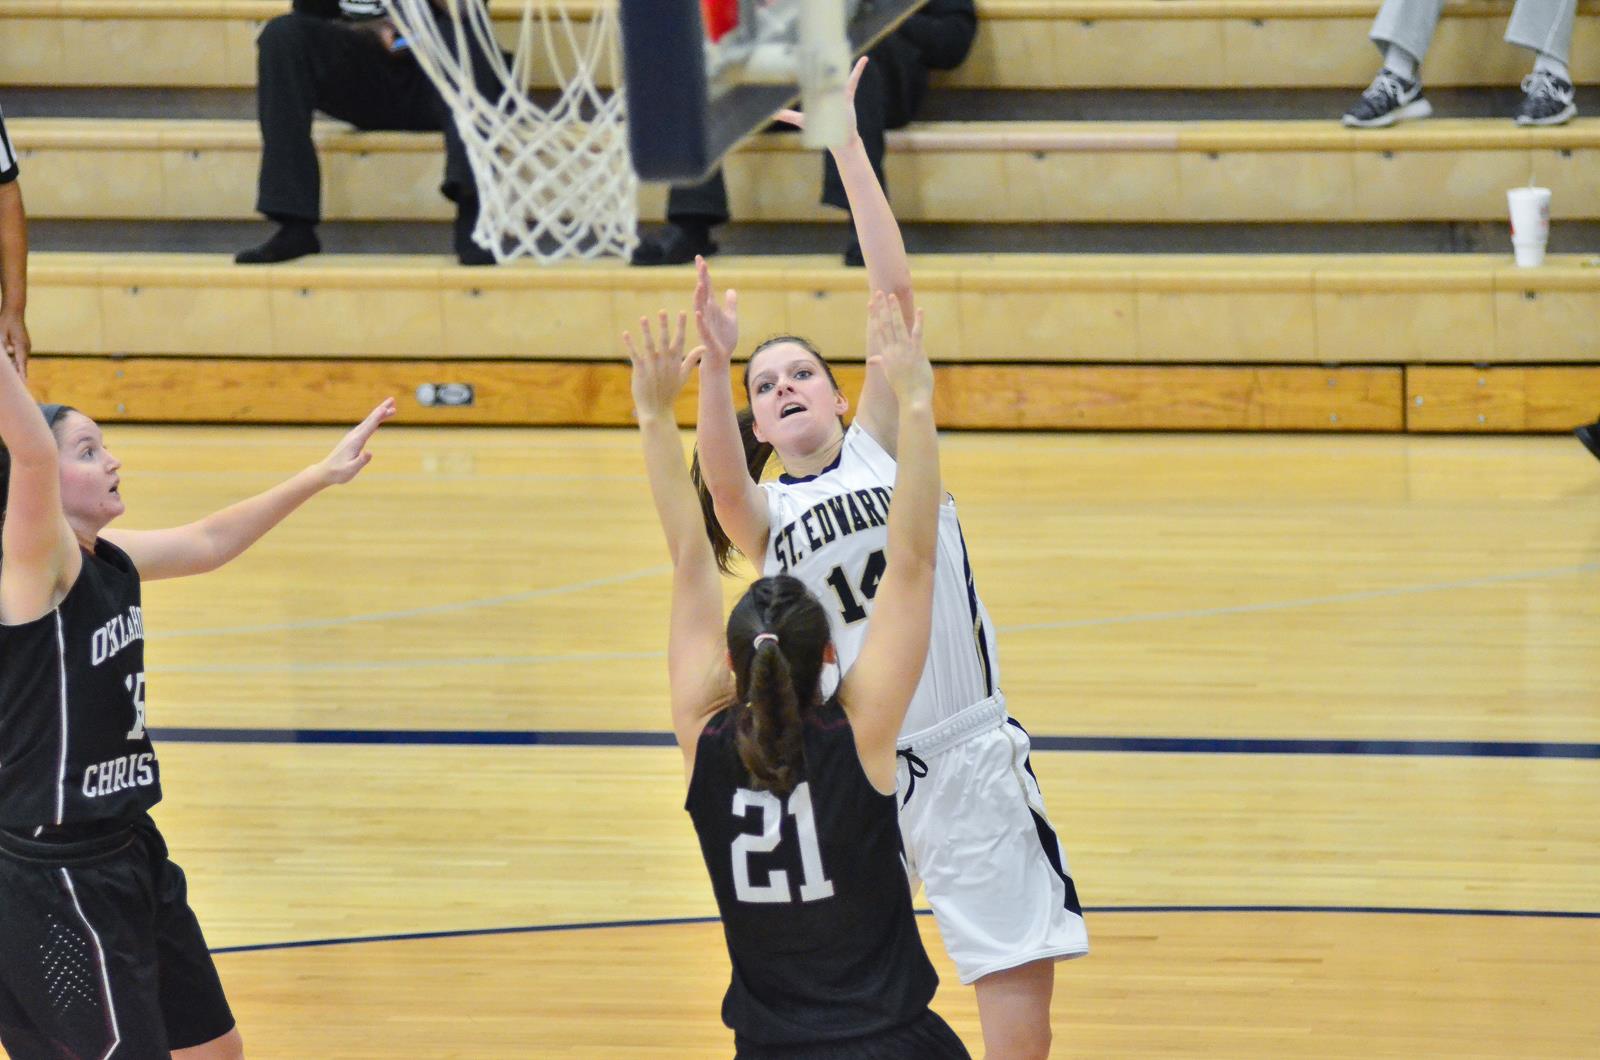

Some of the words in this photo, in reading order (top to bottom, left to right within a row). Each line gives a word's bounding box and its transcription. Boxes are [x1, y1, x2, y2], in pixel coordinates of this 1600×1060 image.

[774, 521, 802, 572] ST.
[801, 486, 893, 551] EDWARD
[82, 753, 158, 797] CHRIS
[730, 781, 834, 903] 21
